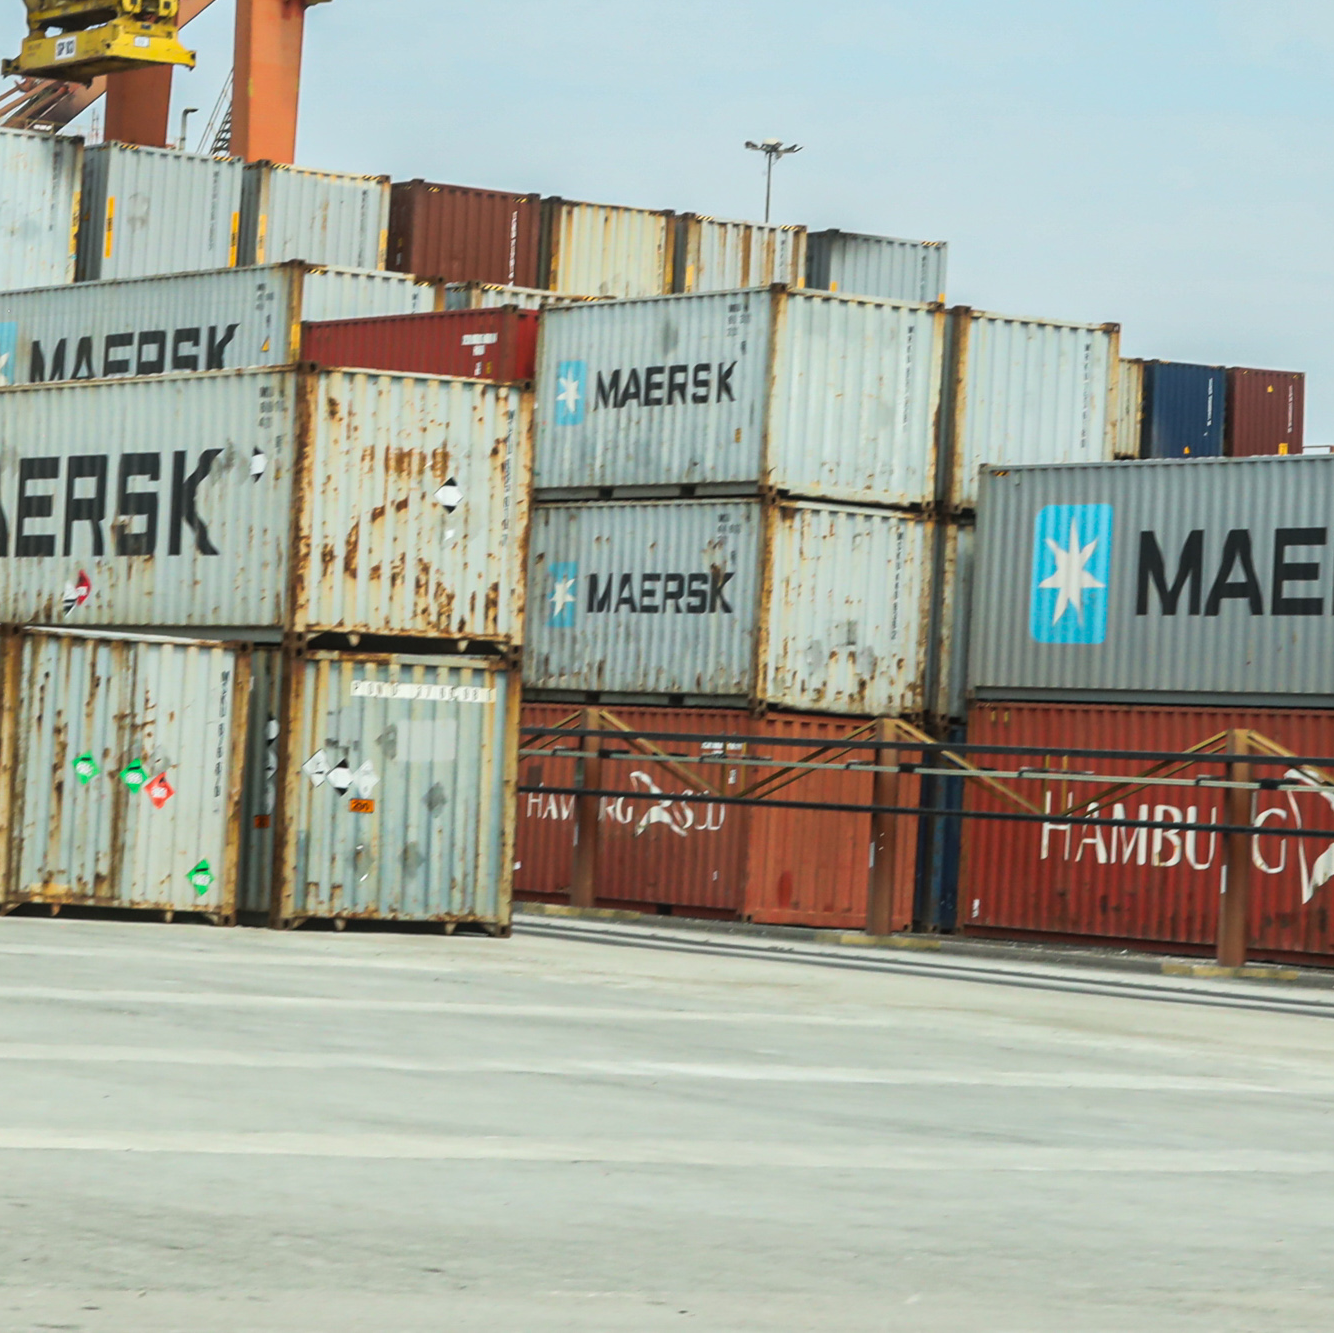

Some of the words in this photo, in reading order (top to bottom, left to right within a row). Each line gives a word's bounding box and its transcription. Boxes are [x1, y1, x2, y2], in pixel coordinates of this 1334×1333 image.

[593, 360, 738, 412] MAERSK
[586, 572, 736, 615] MAERSK
[1040, 790, 1288, 875] HAMBUG
